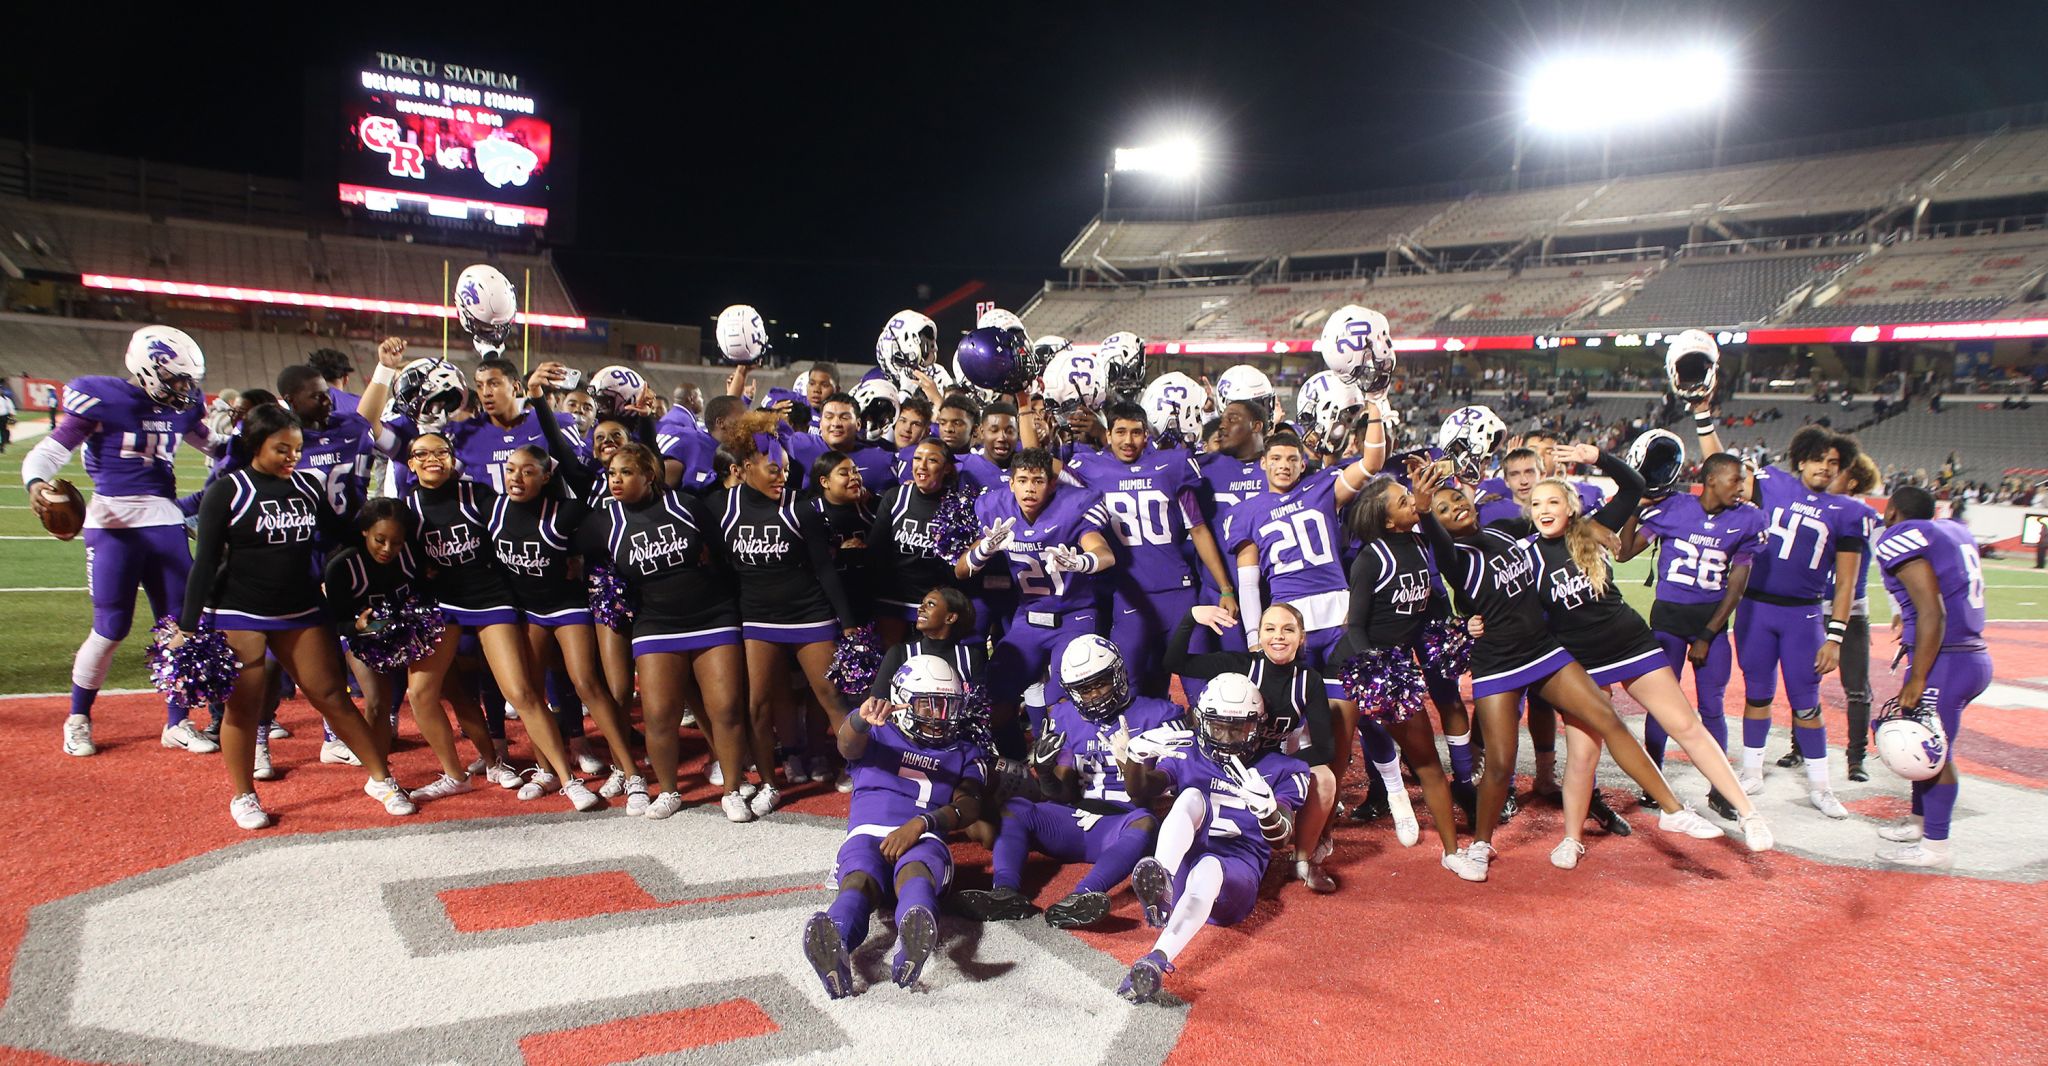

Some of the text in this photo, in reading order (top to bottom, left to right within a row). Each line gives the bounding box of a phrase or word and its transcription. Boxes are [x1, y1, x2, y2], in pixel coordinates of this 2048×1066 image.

[376, 51, 518, 91] TDECU STADIUM
[361, 71, 421, 97] WELCOME
[424, 82, 439, 100] TO
[484, 91, 534, 114] STADIUM
[1337, 321, 1372, 354] 20
[611, 369, 640, 388] 90
[1069, 357, 1095, 386] 33
[142, 419, 173, 432] HUMBLE
[120, 432, 183, 467] 44
[309, 452, 341, 467] HUMBLE
[1119, 478, 1152, 491] HUMBLE
[1229, 479, 1262, 492] HUMBLE
[1105, 490, 1172, 546] 80
[1270, 500, 1305, 521] HUMBLE
[1790, 502, 1823, 519] HUMBLE
[256, 512, 316, 532] Wildcats
[425, 536, 481, 557] Wildcats
[732, 537, 789, 554] Wildcats
[1012, 542, 1043, 553] HUMBLE
[1258, 508, 1334, 575] 20
[1689, 533, 1721, 548] HUMBLE
[1769, 507, 1831, 570] 47
[496, 550, 550, 568] Wildcats
[629, 537, 688, 566] Wildcats
[901, 751, 940, 771] HUMBLE
[898, 766, 933, 809] 7
[1208, 792, 1248, 838] 5
